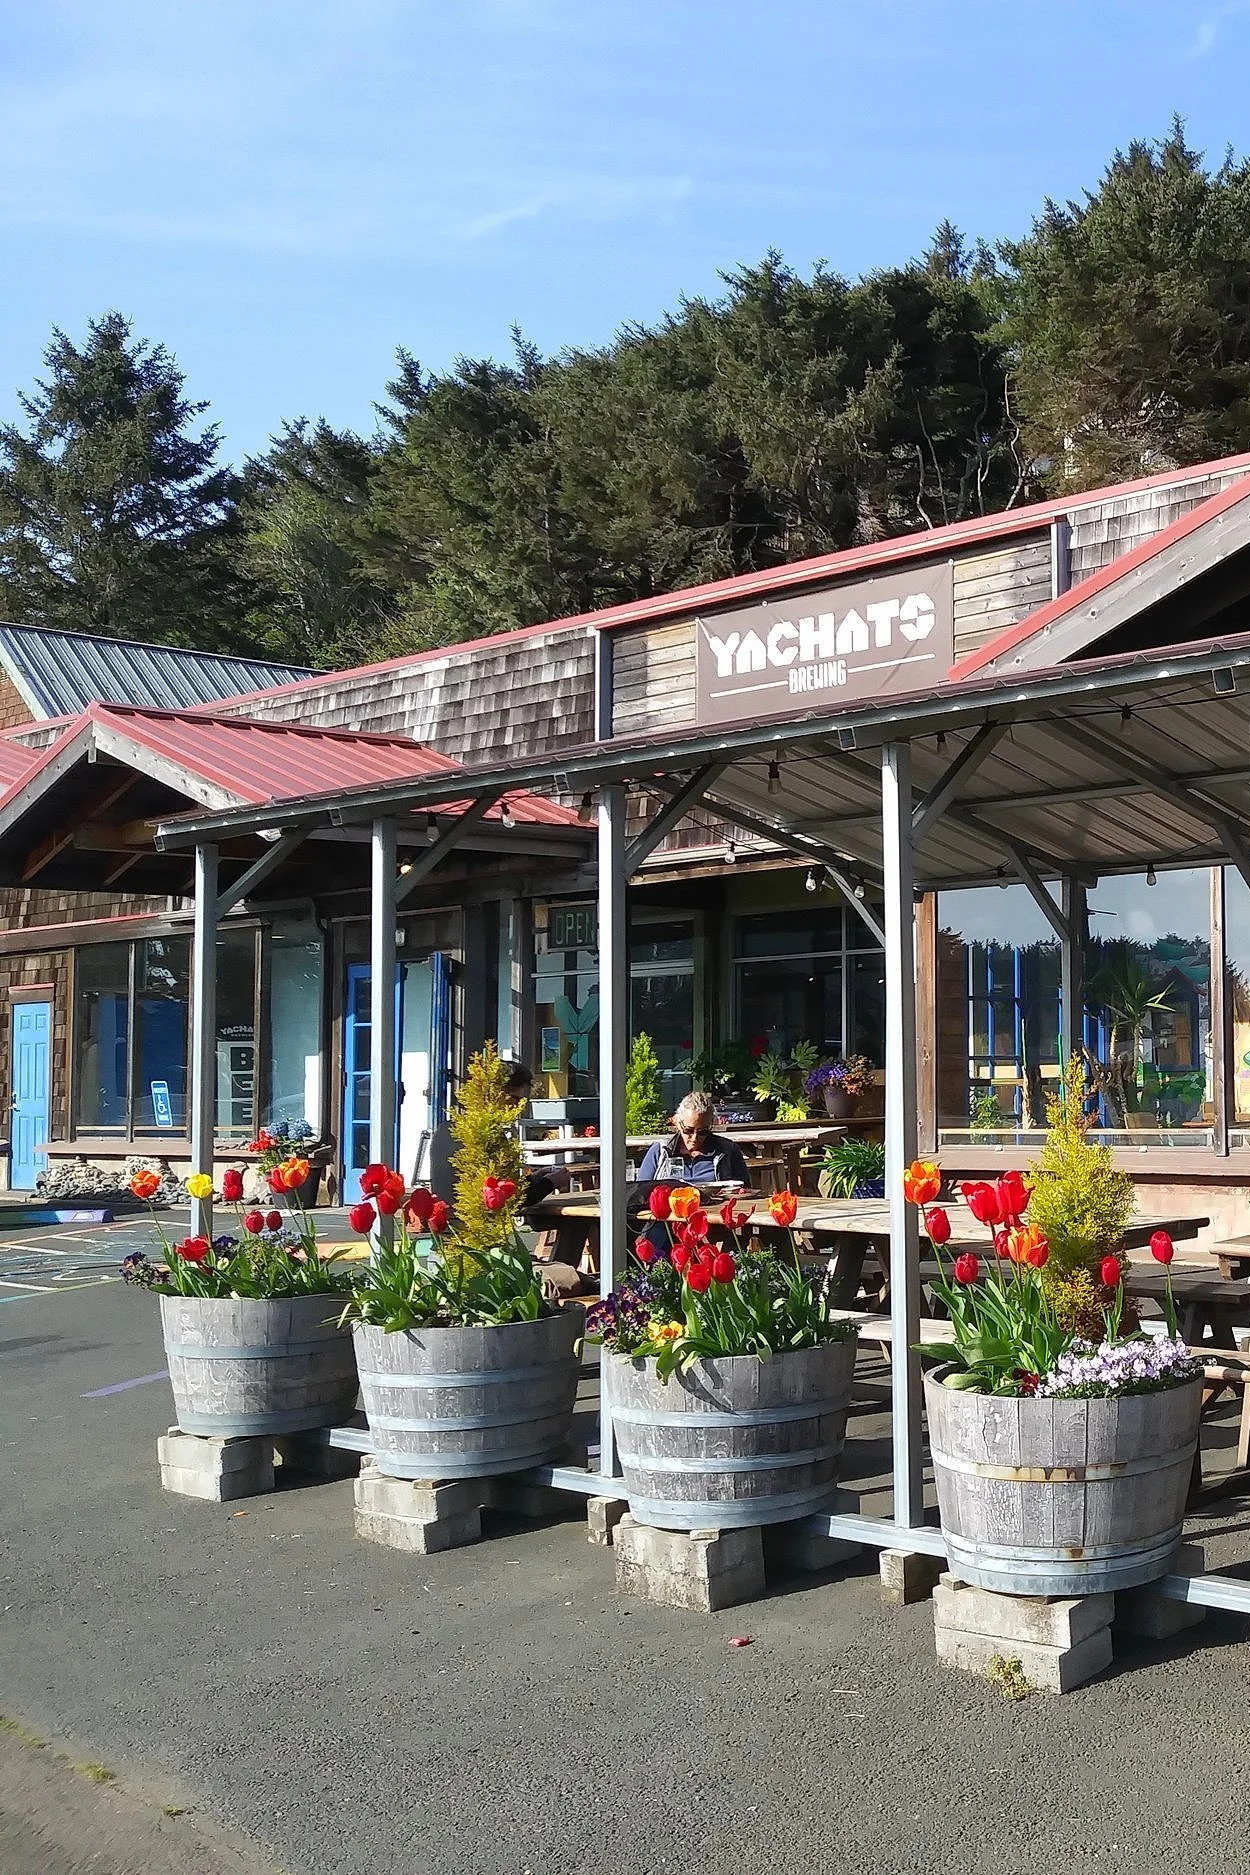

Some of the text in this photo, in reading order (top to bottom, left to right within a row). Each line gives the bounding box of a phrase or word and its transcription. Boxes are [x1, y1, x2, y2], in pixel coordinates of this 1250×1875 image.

[710, 592, 936, 678] YACHATS
[788, 660, 848, 694] BREWING
[555, 911, 595, 945] OPEN
[220, 1025, 255, 1035] YACHA
